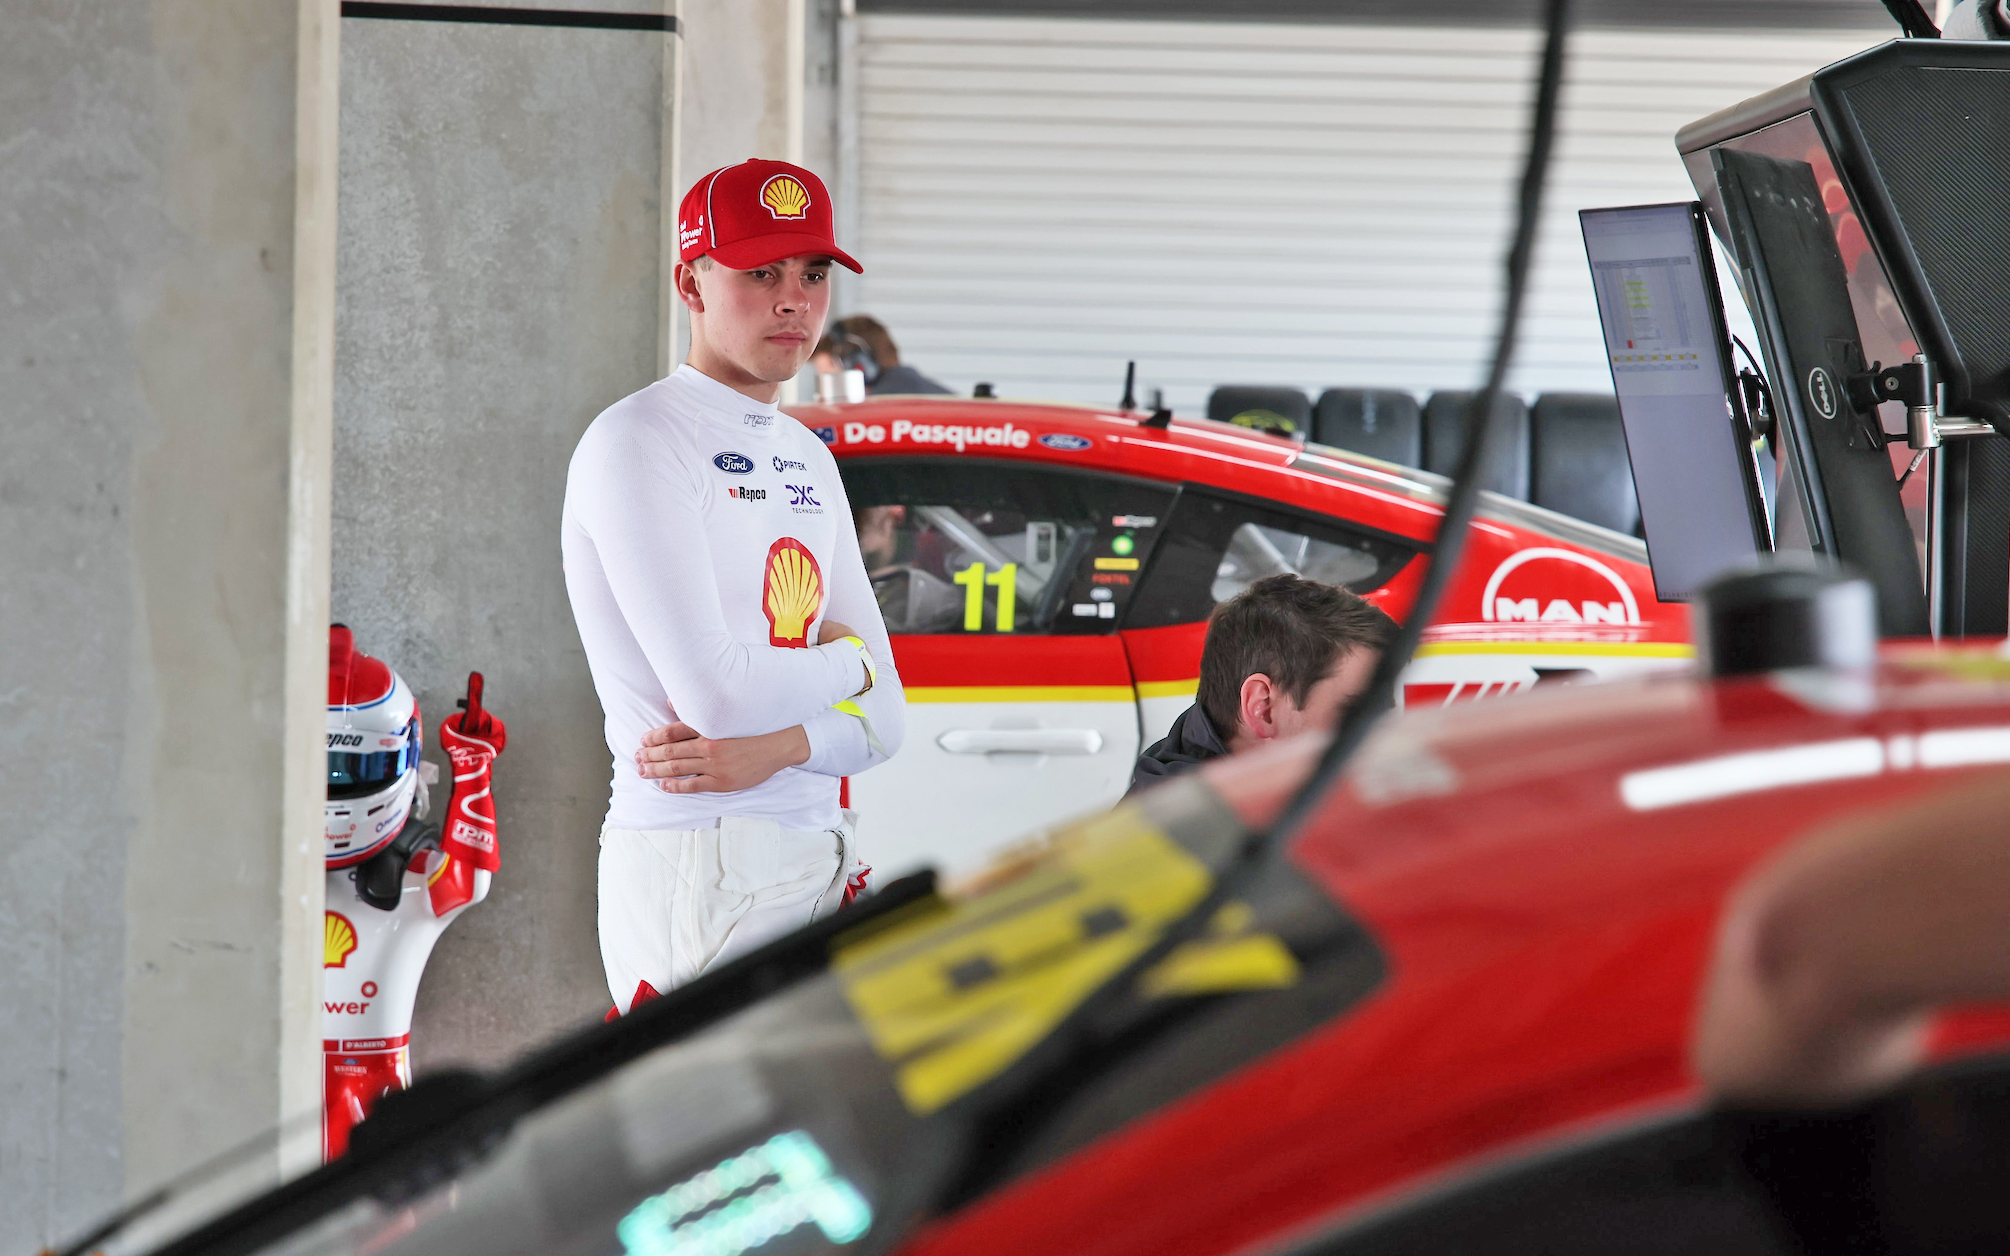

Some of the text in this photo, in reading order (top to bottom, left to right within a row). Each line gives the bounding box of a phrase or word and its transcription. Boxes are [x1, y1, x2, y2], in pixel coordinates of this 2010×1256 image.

[1816, 372, 1831, 413] DELL
[843, 419, 1031, 452] De Pasquale
[721, 454, 749, 471] Ford
[783, 460, 807, 472] PIRTEK
[738, 486, 766, 502] Repco
[785, 484, 821, 506] DXC
[792, 507, 824, 515] TECHNOLOGY
[953, 562, 1017, 632] 11
[1495, 597, 1627, 625] MAN
[456, 822, 495, 844] rpm
[345, 1040, 387, 1049] D'ALBERTO
